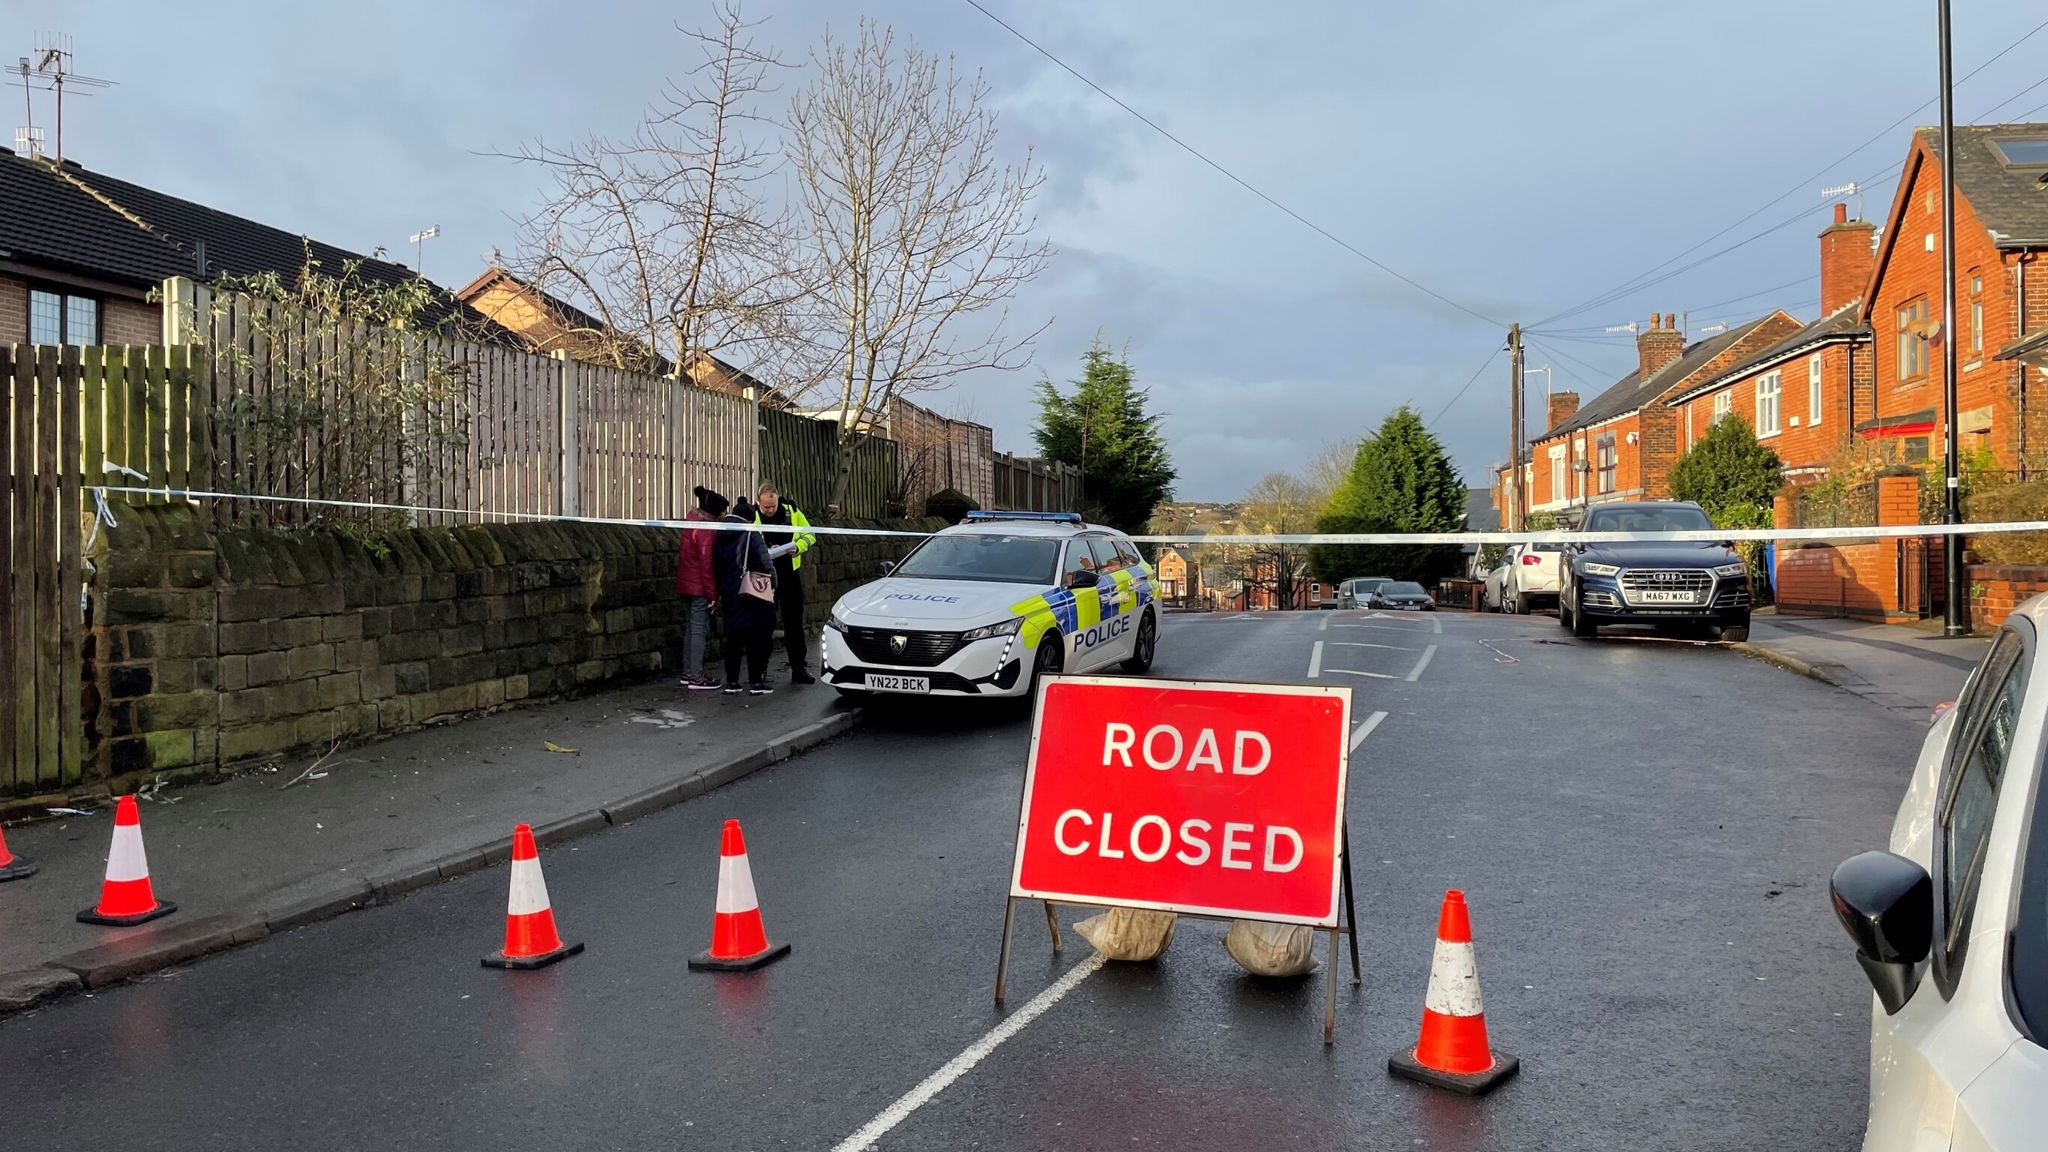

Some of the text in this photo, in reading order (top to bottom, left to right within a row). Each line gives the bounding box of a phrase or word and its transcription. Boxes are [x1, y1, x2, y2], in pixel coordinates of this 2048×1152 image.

[885, 593, 960, 604] POLICE
[1646, 592, 1690, 601] HA67 WXG
[1074, 615, 1130, 652] POLICE
[870, 675, 925, 691] YN22 BCK
[1102, 722, 1272, 776] ROAD
[1054, 808, 1304, 873] CLOSED
